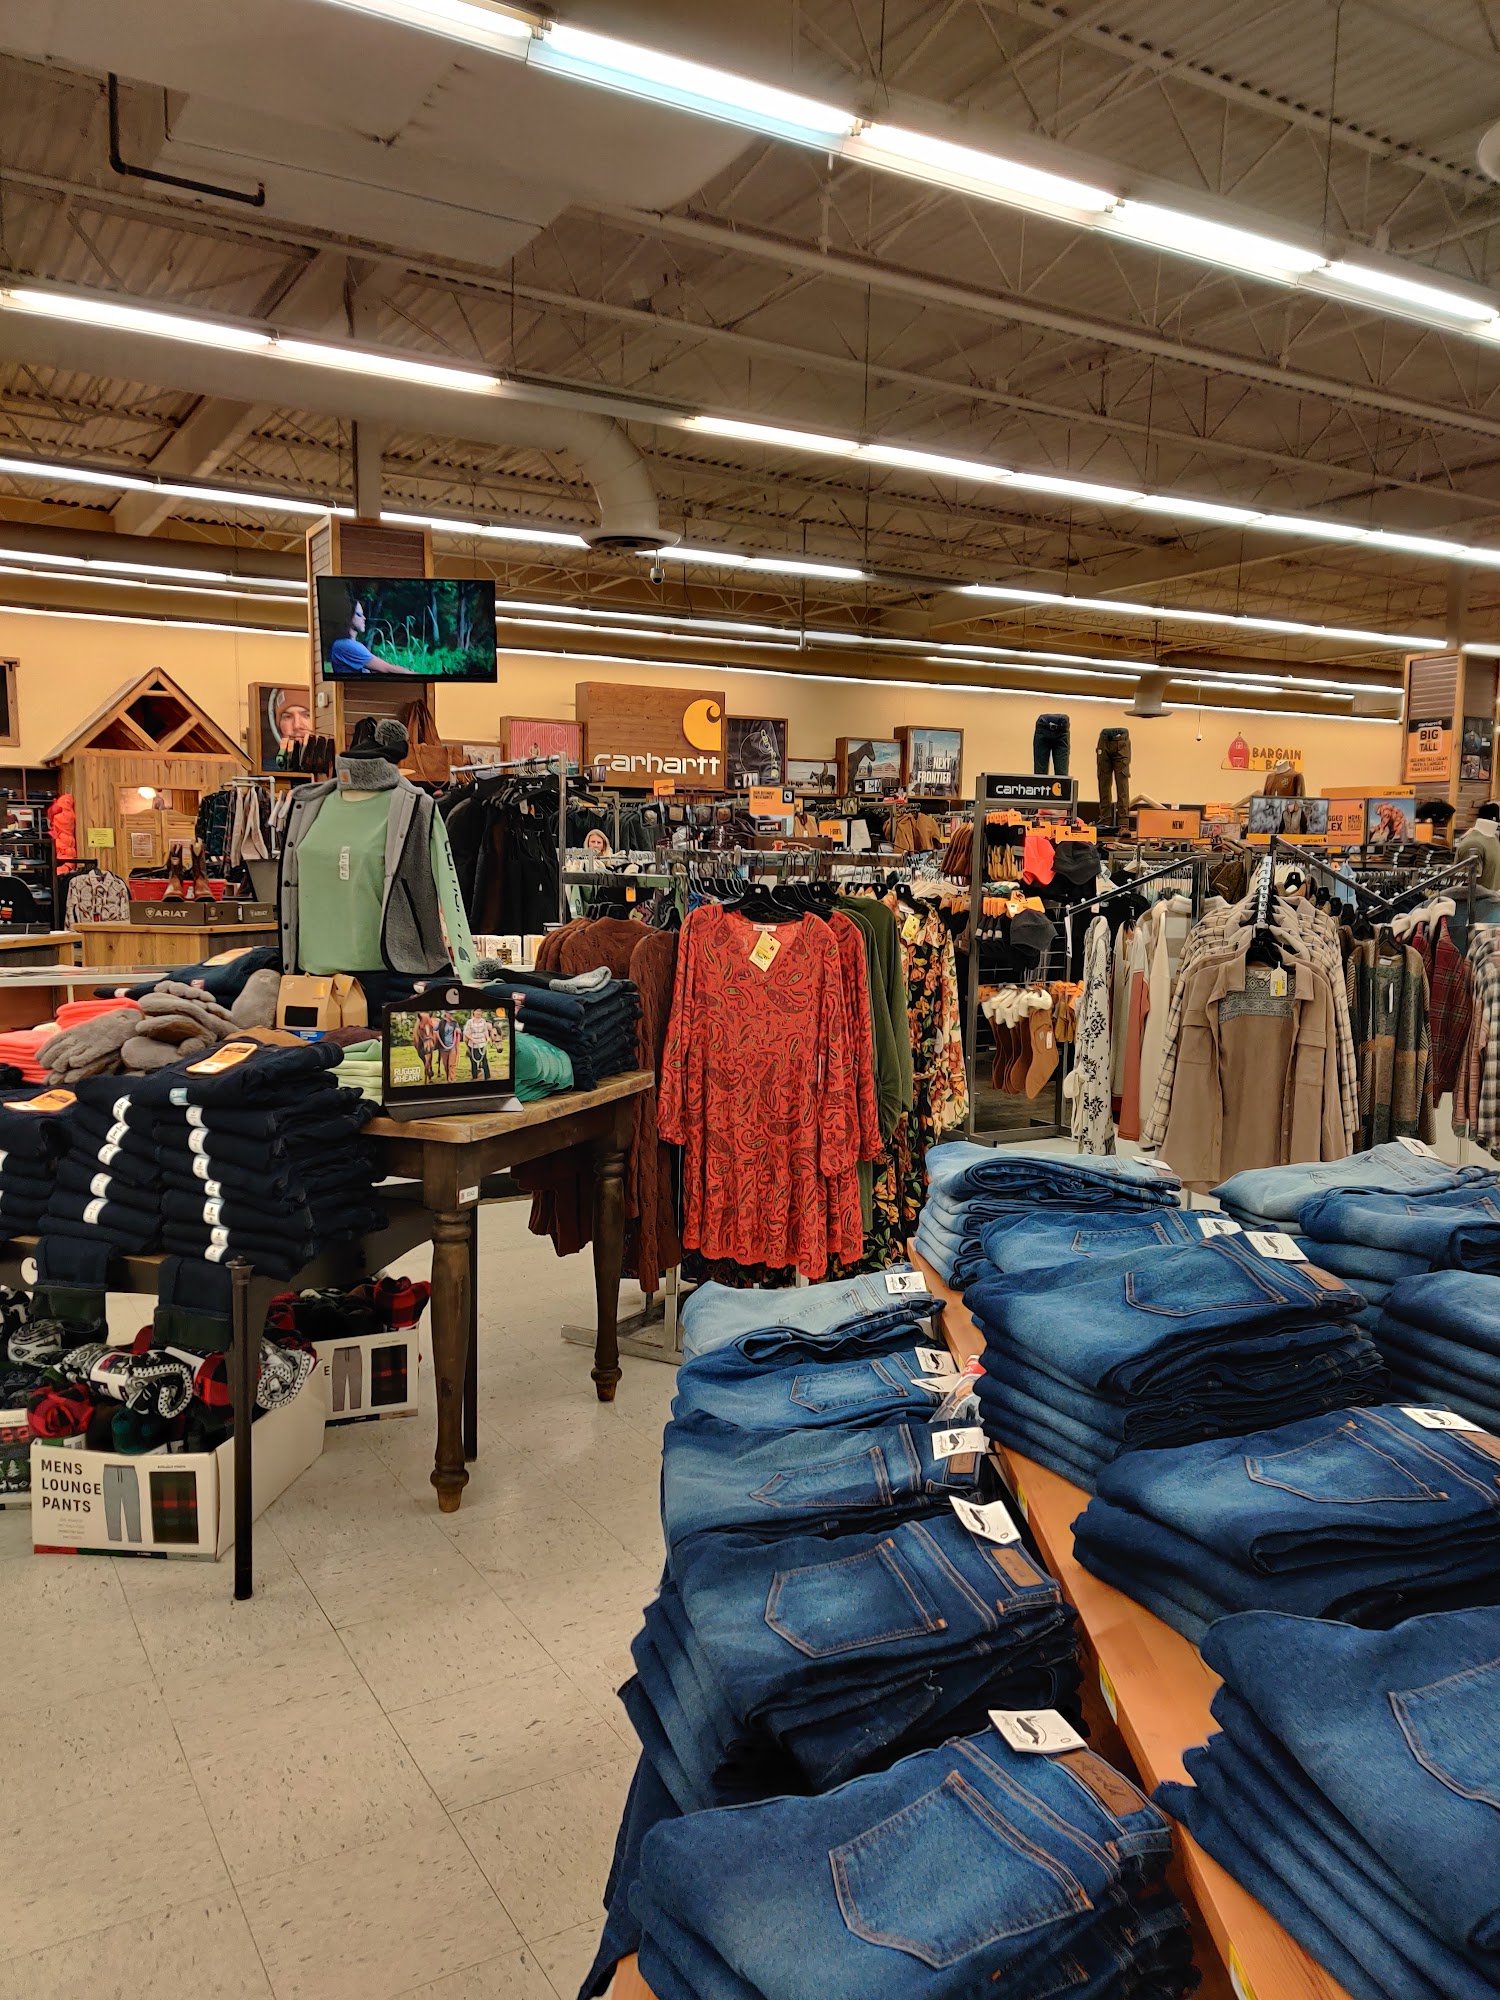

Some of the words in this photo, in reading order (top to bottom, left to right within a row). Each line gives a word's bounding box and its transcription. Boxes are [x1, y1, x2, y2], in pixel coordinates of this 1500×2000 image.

[1420, 729, 1438, 741] BIG
[1252, 747, 1301, 760] BARGAIN
[1419, 743, 1437, 752] TALL
[593, 752, 721, 775] carhartt
[933, 757, 951, 770] NEXT
[917, 771, 951, 784] FRONTIER
[995, 784, 1051, 796] carhartt
[155, 910, 188, 918] ARIAT
[41, 1459, 83, 1475] MENS
[41, 1477, 102, 1495] LOUNGE
[42, 1496, 91, 1513] PANTS
